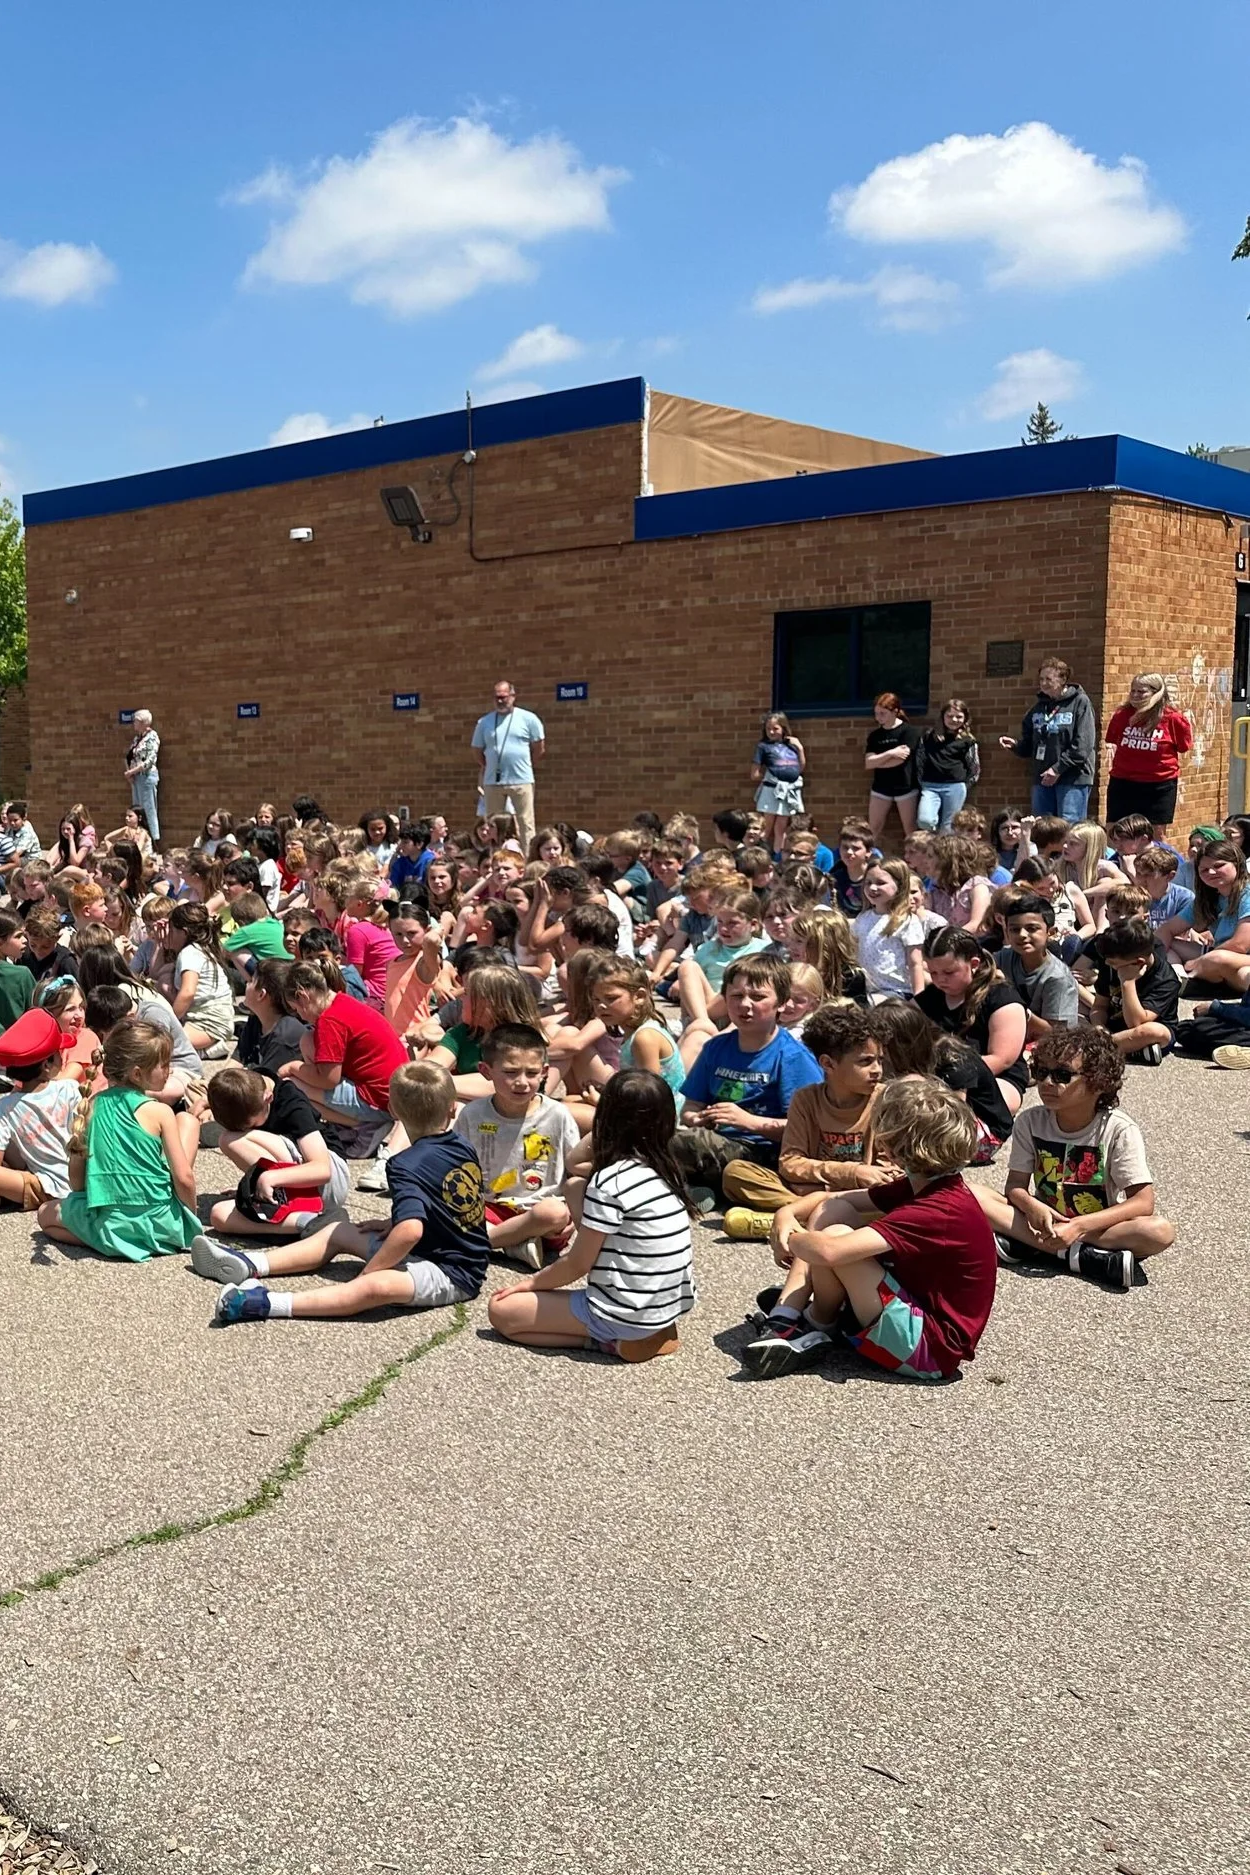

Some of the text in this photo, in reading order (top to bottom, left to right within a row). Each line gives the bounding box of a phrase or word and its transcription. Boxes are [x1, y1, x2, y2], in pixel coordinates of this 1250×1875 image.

[1238, 553, 1245, 569] 6
[560, 686, 576, 697] Room
[396, 697, 410, 706] Room
[1120, 737, 1158, 752] PRIDE
